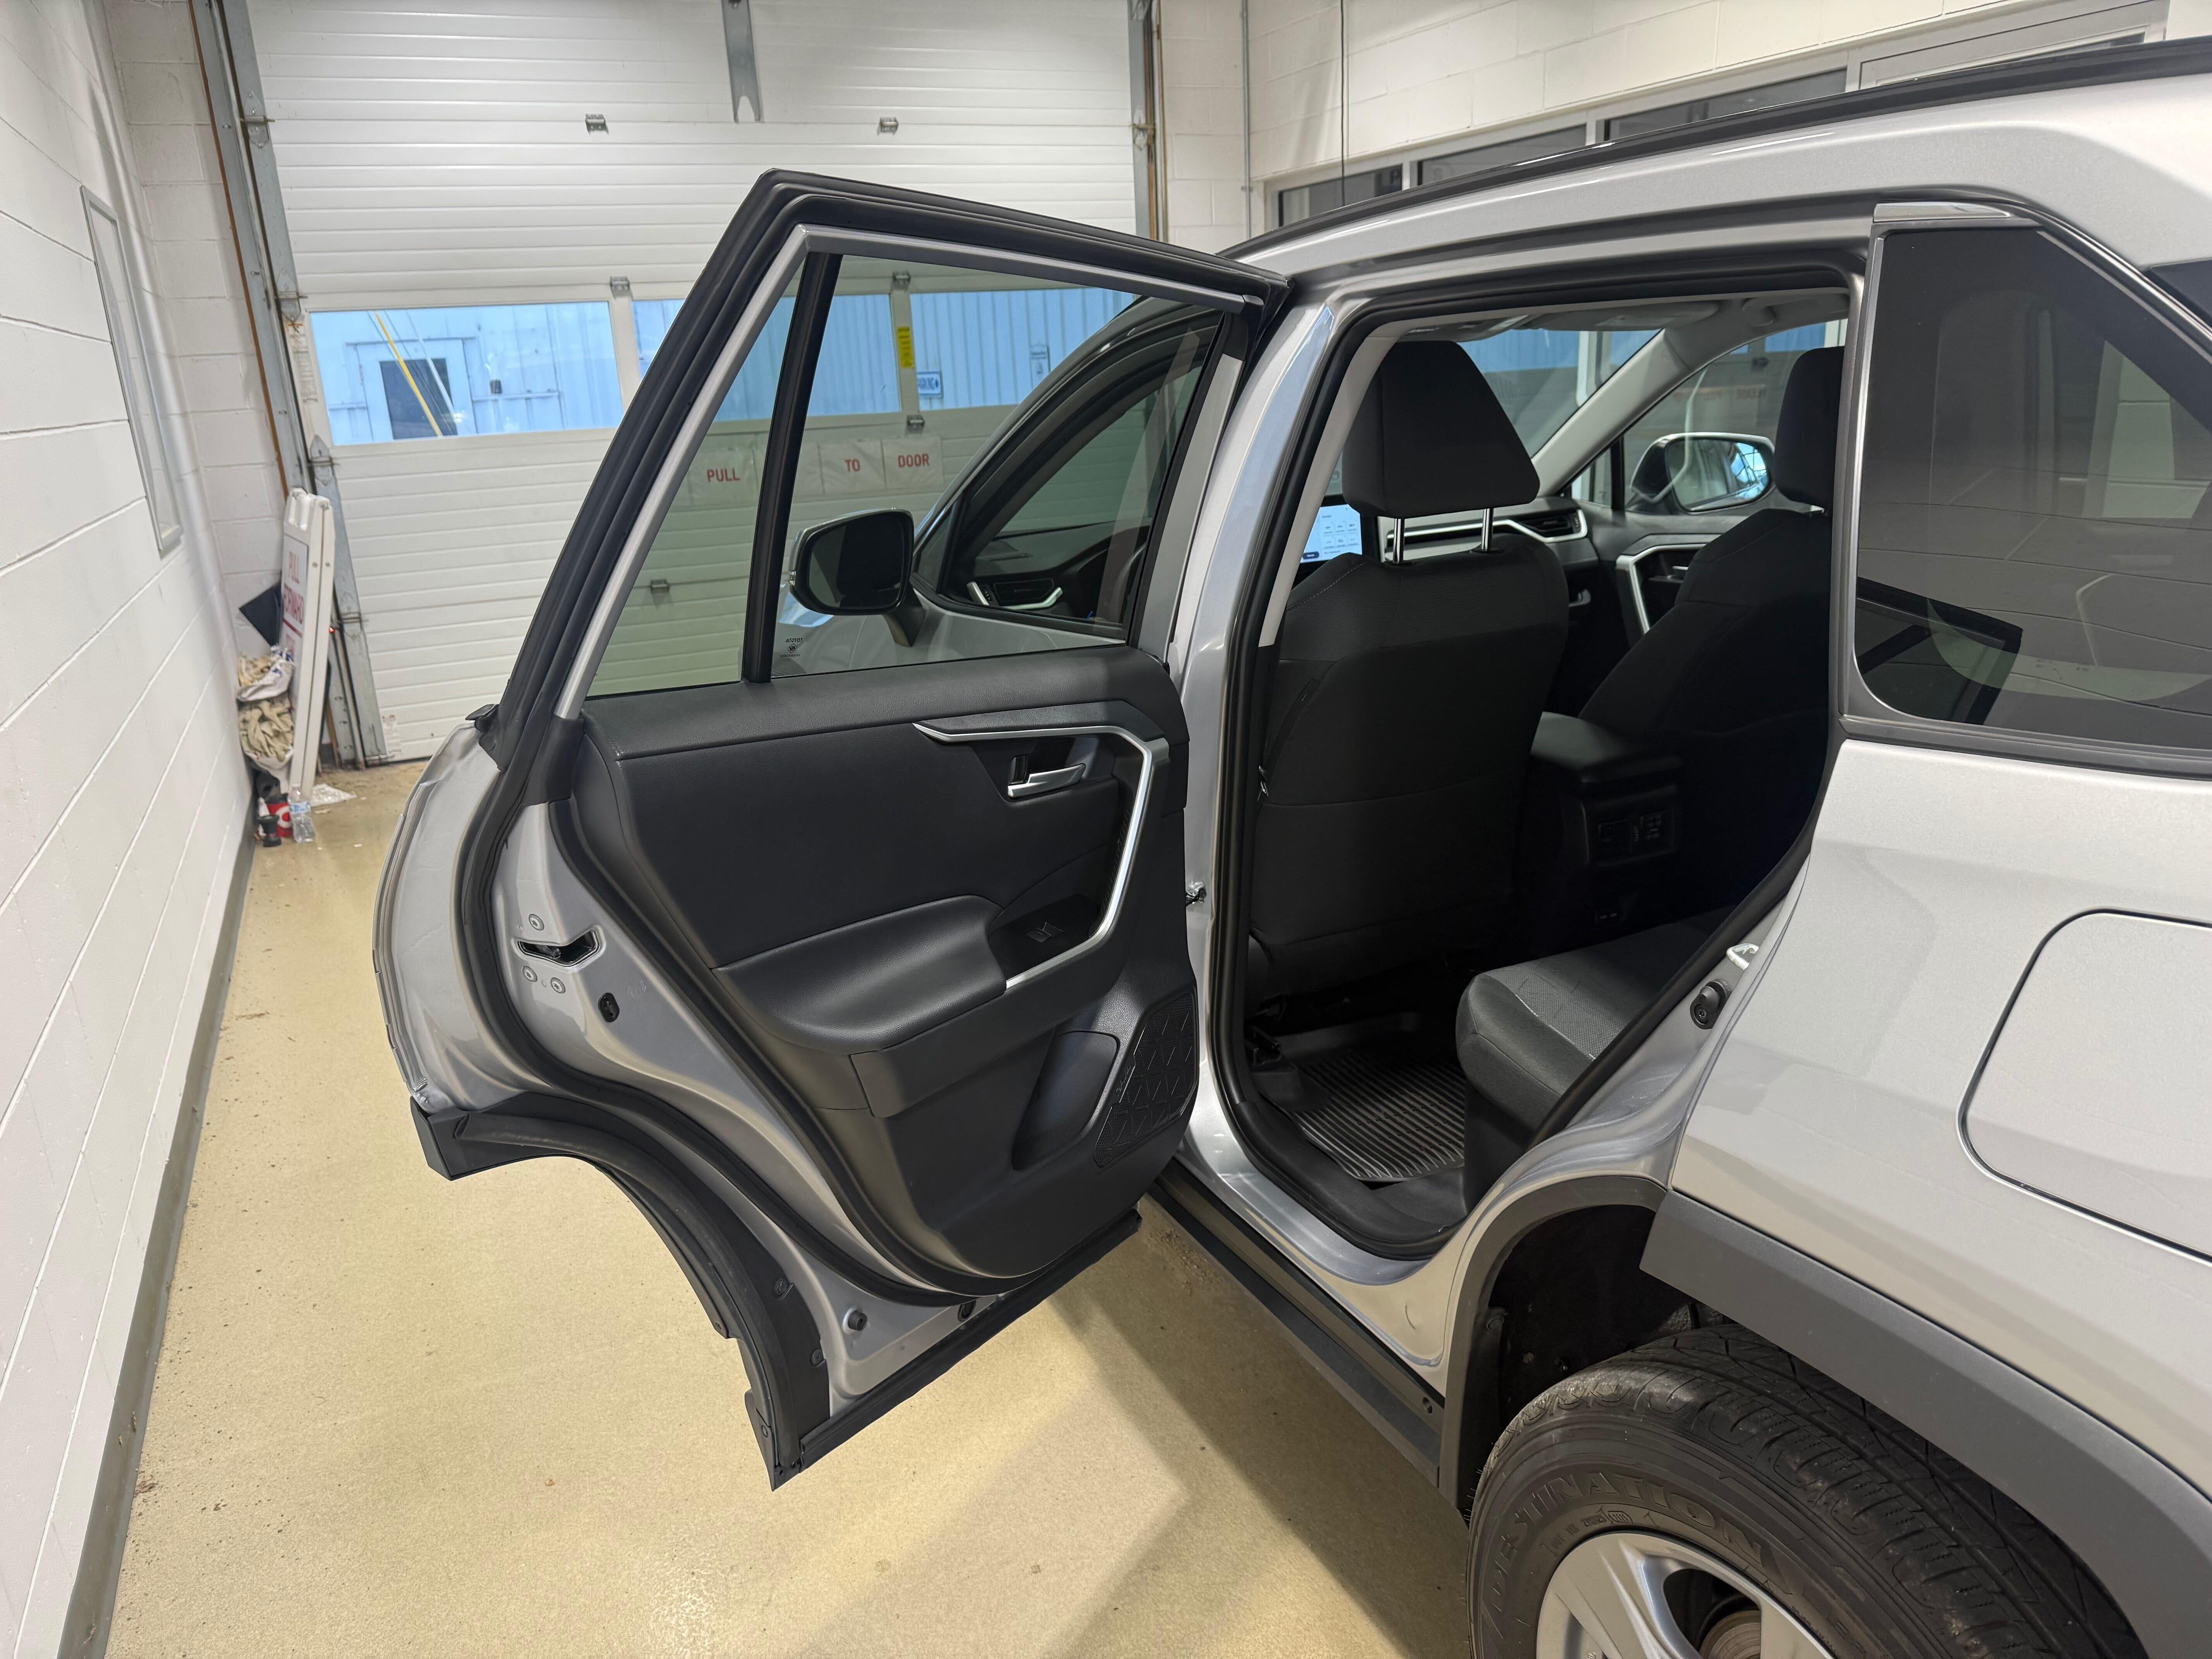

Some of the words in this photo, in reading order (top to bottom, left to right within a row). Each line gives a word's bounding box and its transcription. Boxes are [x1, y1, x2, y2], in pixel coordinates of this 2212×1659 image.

[707, 468, 740, 483] PULL
[845, 459, 860, 472] TO
[898, 453, 929, 468] DOOR
[1492, 1472, 1793, 1613] DESTINATION
